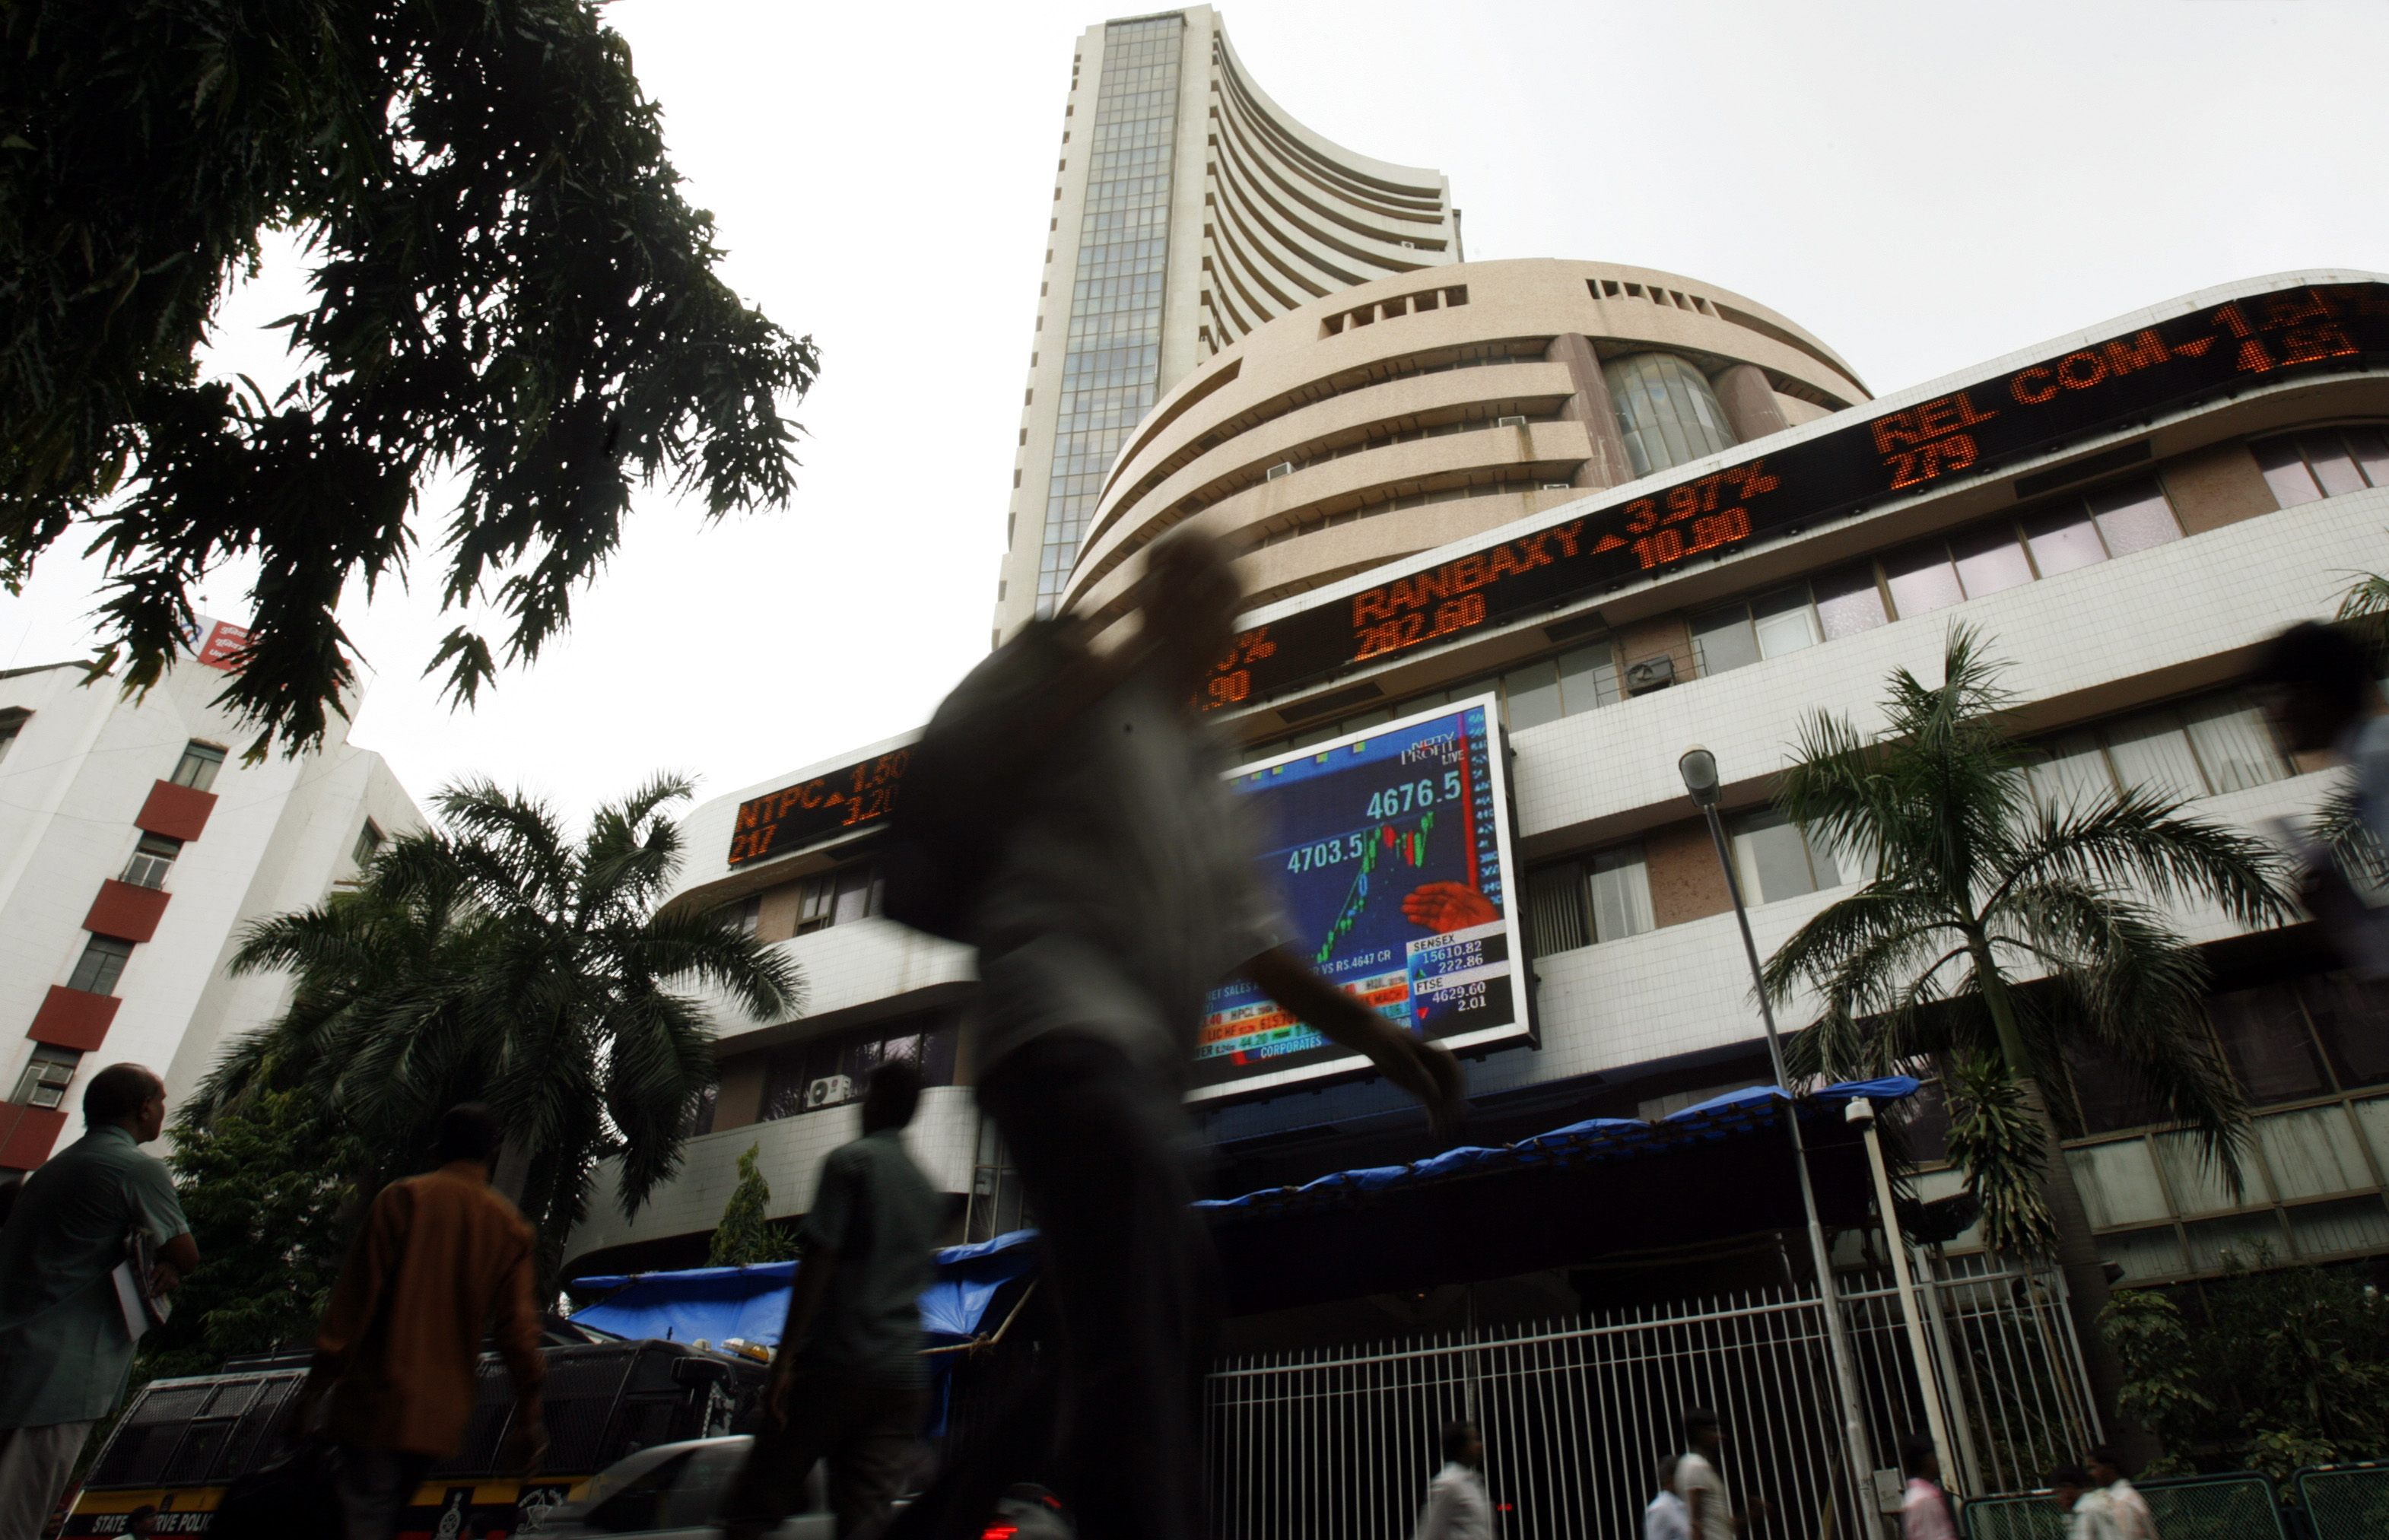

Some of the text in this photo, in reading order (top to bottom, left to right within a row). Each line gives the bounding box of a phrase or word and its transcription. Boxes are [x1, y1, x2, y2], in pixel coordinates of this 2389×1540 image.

[1871, 392, 2000, 454] REL
[2009, 329, 2172, 405] COM
[1882, 433, 1979, 490] 279
[1352, 459, 1781, 627] RANBAXY 3.97%
[1631, 506, 1752, 569] 10.80
[1188, 669, 1251, 712] .90
[1401, 738, 1457, 765] PROFIT
[1412, 731, 1454, 751] NDTV
[1442, 749, 1466, 766] LIVE
[735, 778, 825, 833] NTPC
[1367, 770, 1460, 819] 4676.5
[729, 824, 778, 863] 217
[1287, 834, 1363, 874] 4703.5
[1414, 934, 1455, 952] SENSEX
[1423, 941, 1482, 964] 15610.82
[1322, 964, 1334, 974] VS
[1336, 951, 1374, 972] RS.4647
[1377, 950, 1391, 962] CR
[1438, 954, 1483, 973] 222.86
[1224, 983, 1252, 998] SALES
[1417, 977, 1443, 992] FTSE
[1432, 982, 1485, 1003] 4629.60
[1458, 995, 1486, 1012] 2.01
[1260, 1035, 1323, 1058] CORPORATES
[91, 1514, 129, 1533] STATE
[178, 1513, 216, 1532] POLIC
